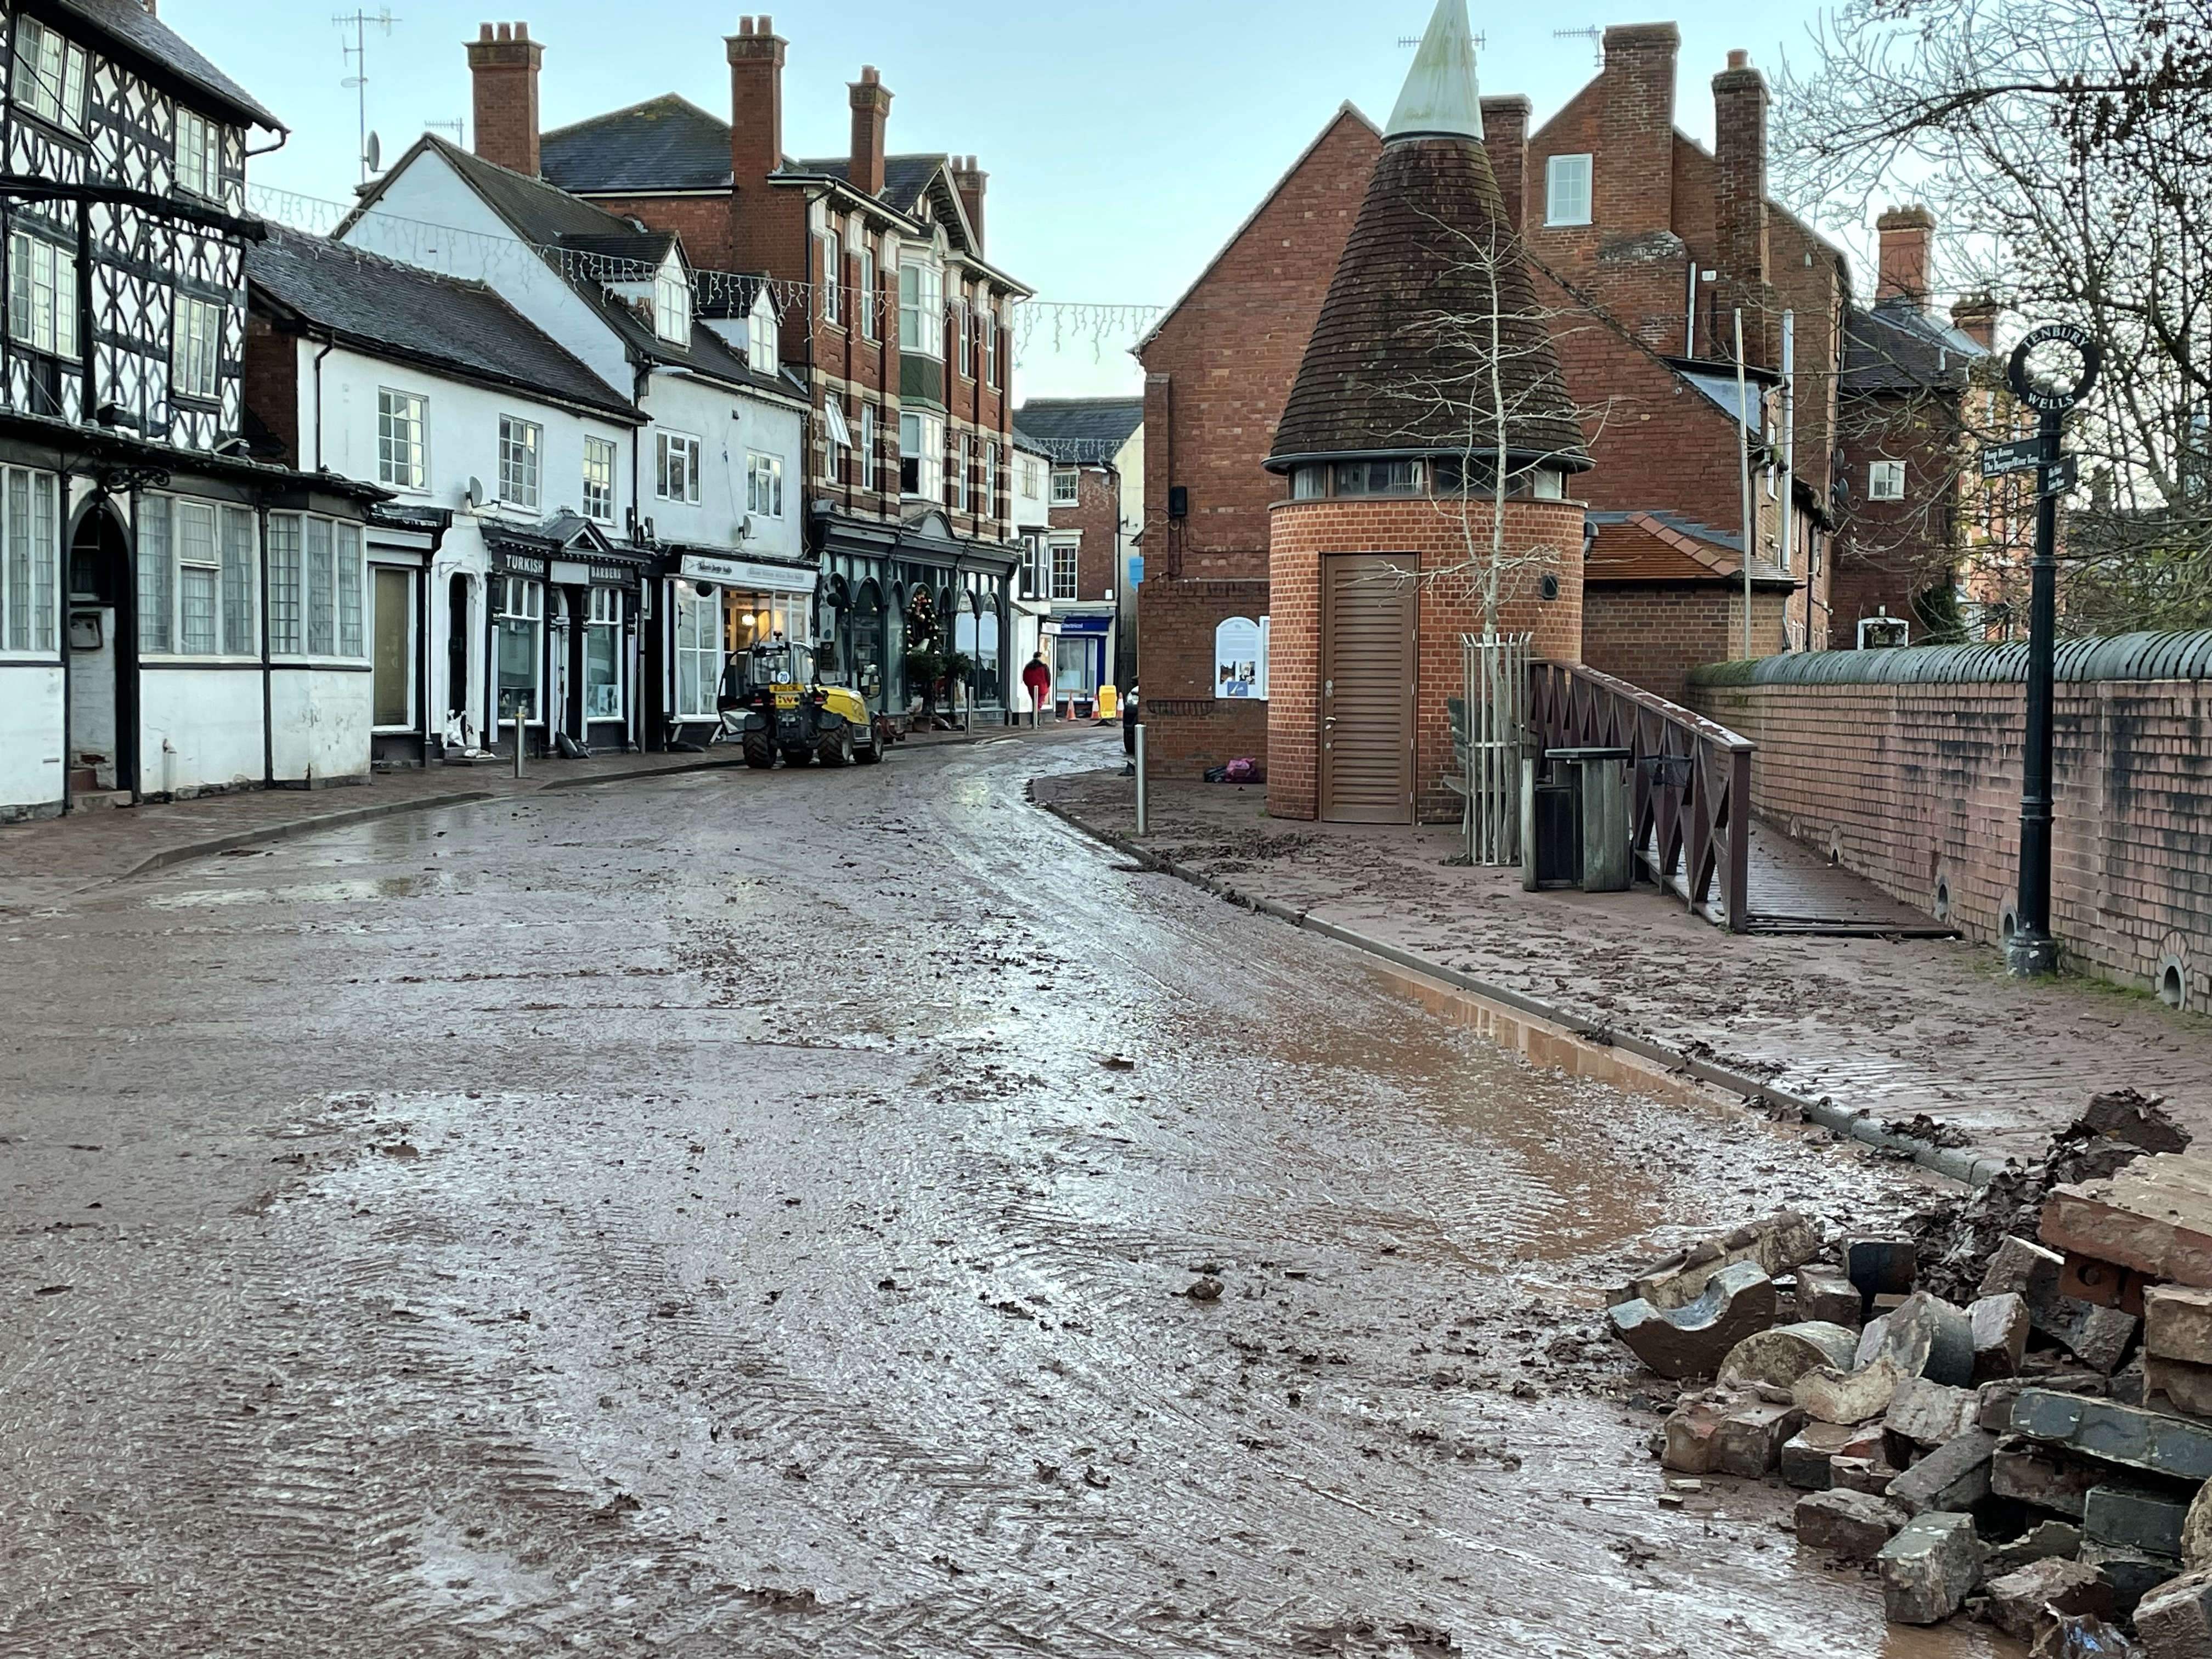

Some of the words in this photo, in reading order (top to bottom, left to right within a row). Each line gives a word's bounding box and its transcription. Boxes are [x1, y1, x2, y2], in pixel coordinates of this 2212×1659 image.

[2022, 327, 2090, 348] TENBURY
[2028, 393, 2074, 409] WELLS
[506, 554, 544, 573] TURKISH
[591, 566, 621, 579] BARBERS
[780, 673, 788, 682] 20
